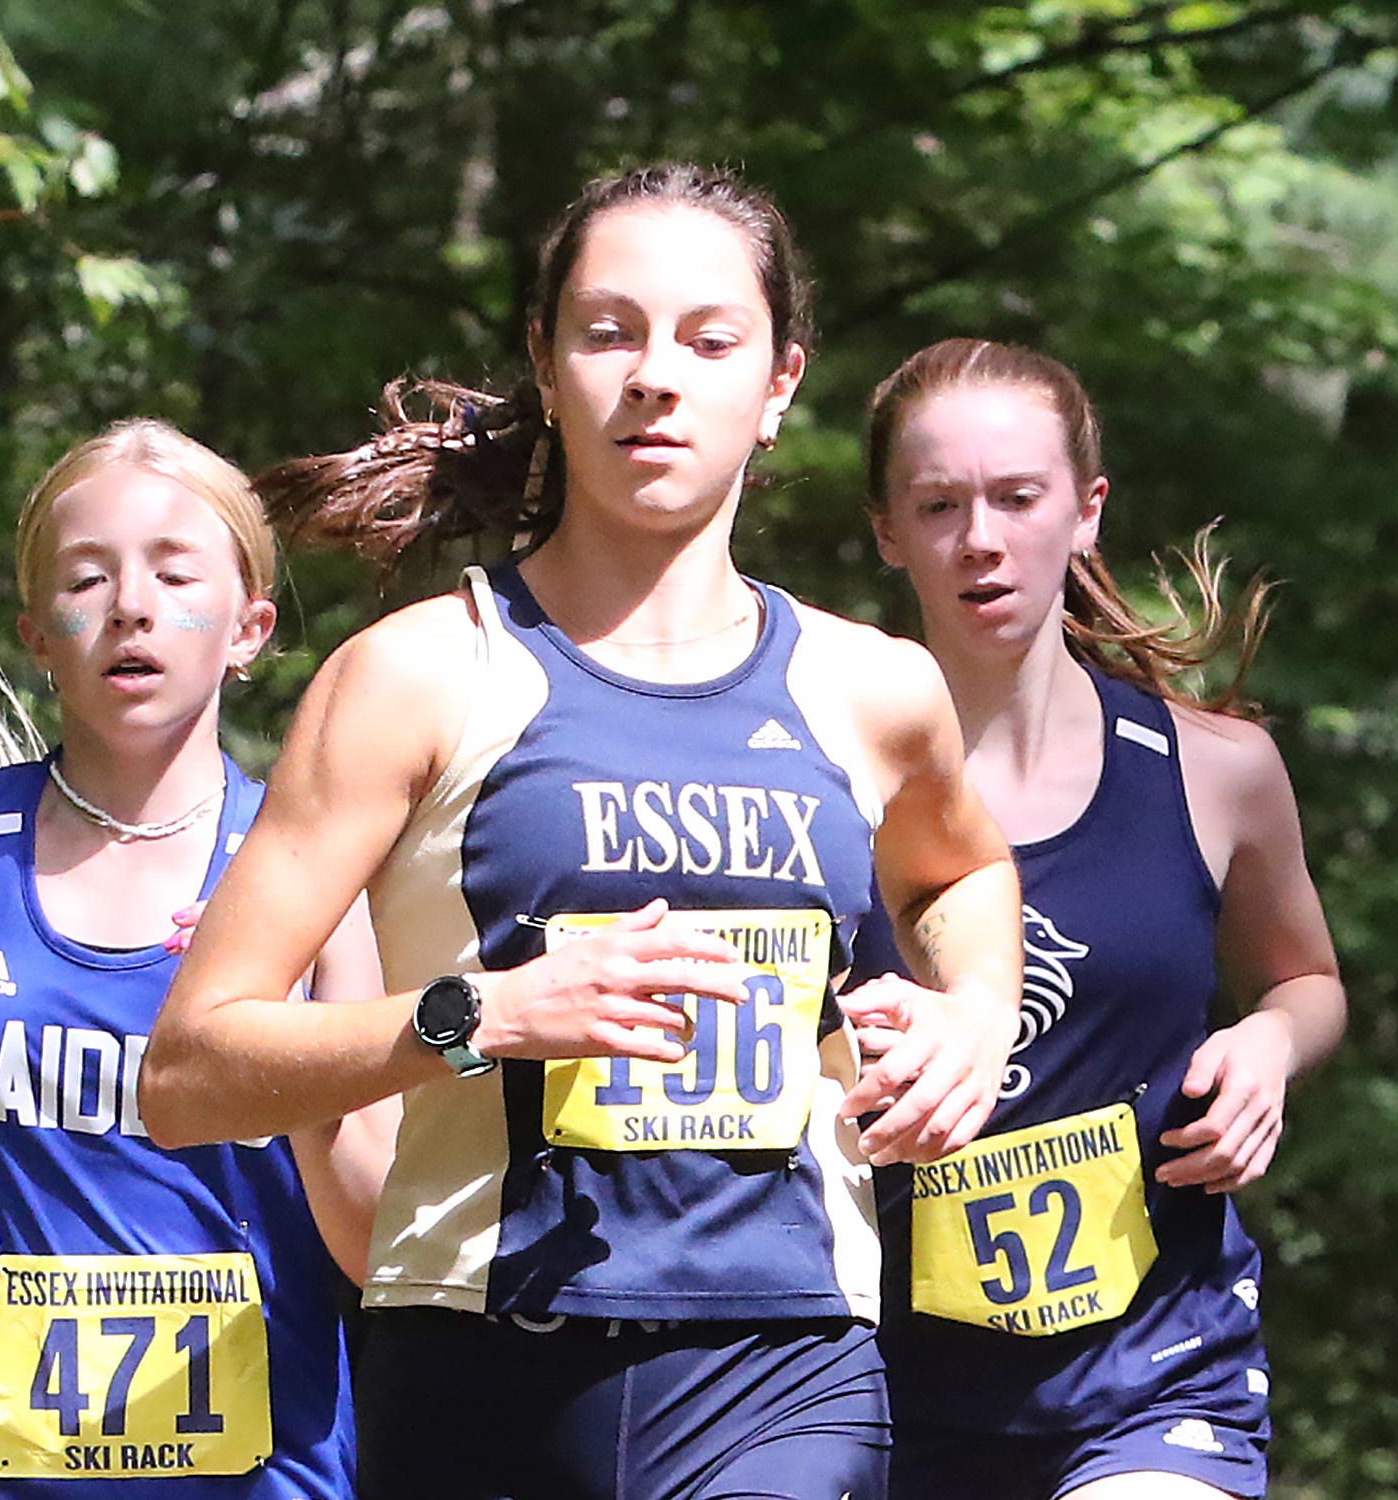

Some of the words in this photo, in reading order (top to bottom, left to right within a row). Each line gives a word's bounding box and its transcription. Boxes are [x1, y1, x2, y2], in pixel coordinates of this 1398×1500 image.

[572, 781, 827, 887] ESSEX
[623, 1116, 669, 1142] SKI
[681, 1114, 756, 1140] RACK
[973, 1121, 1125, 1188] INVITATIONAL
[963, 1179, 1098, 1306] 52
[7, 1270, 79, 1306] ESSEX
[86, 1268, 251, 1306] INVITATIONAL
[1038, 1290, 1104, 1327] RACK
[29, 1314, 225, 1437] 471
[64, 1444, 111, 1471] SKI
[120, 1442, 195, 1470] RACK
